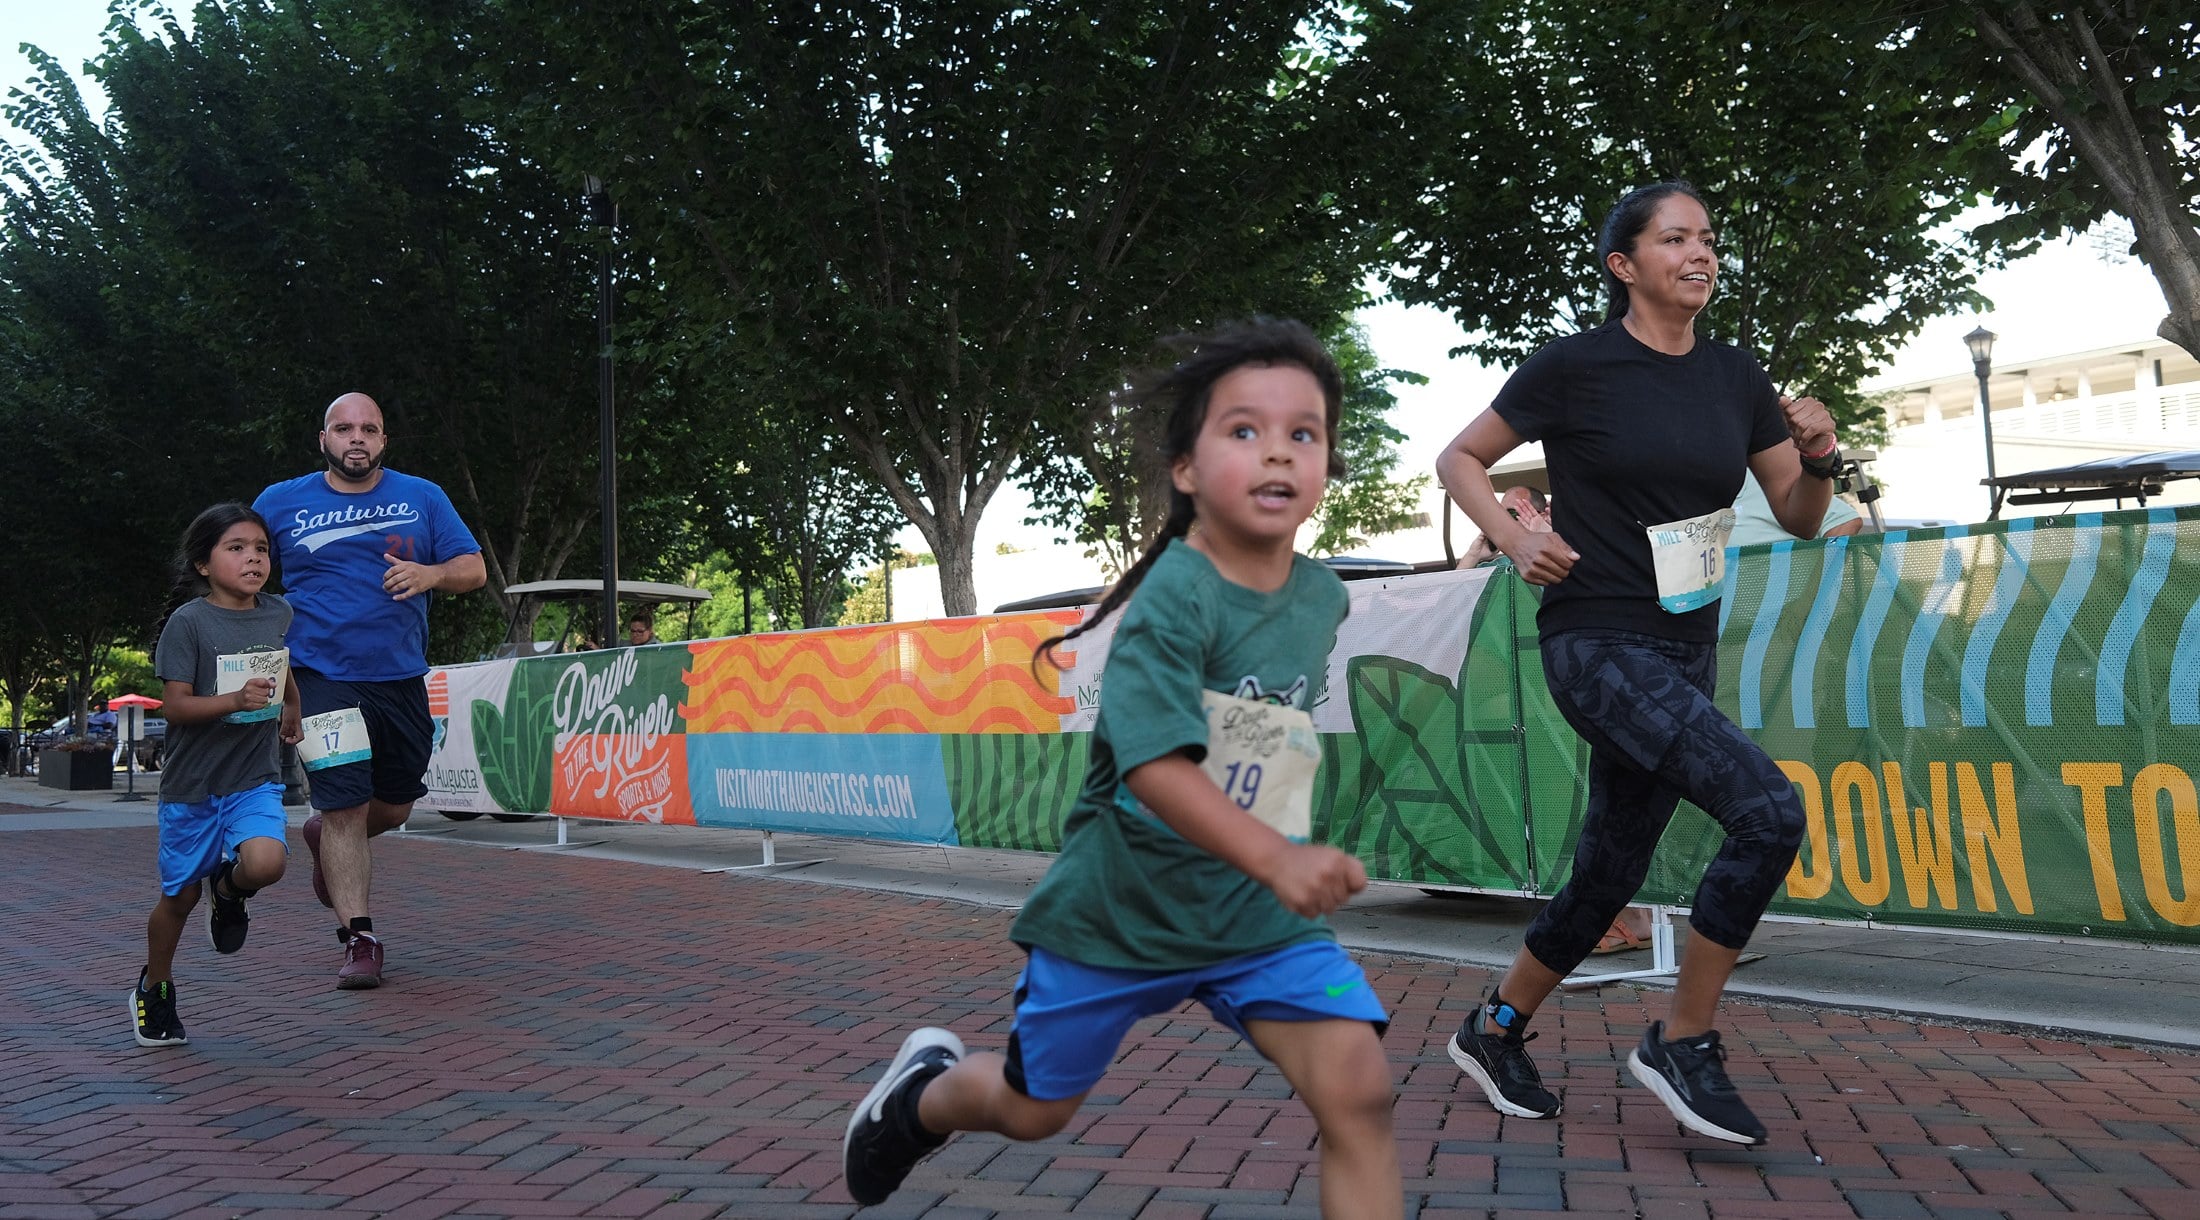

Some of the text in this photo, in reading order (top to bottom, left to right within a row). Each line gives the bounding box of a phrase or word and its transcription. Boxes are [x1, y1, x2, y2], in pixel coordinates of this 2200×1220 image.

[290, 502, 417, 538] Santurce
[1656, 529, 1682, 547] MILE
[384, 534, 415, 560] 21
[1700, 546, 1716, 579] 16
[223, 659, 245, 673] MILE
[553, 648, 639, 753] Down
[321, 731, 340, 751] 17
[592, 693, 675, 799] River
[436, 763, 479, 795] Augusta
[564, 739, 589, 790] TO THE
[1225, 761, 1263, 811] 19
[618, 762, 671, 817] SPORTS & MUSIC
[715, 768, 918, 819] VISITNORTHAUGUSTASC.COM
[1774, 760, 2200, 927] DOWN TO
